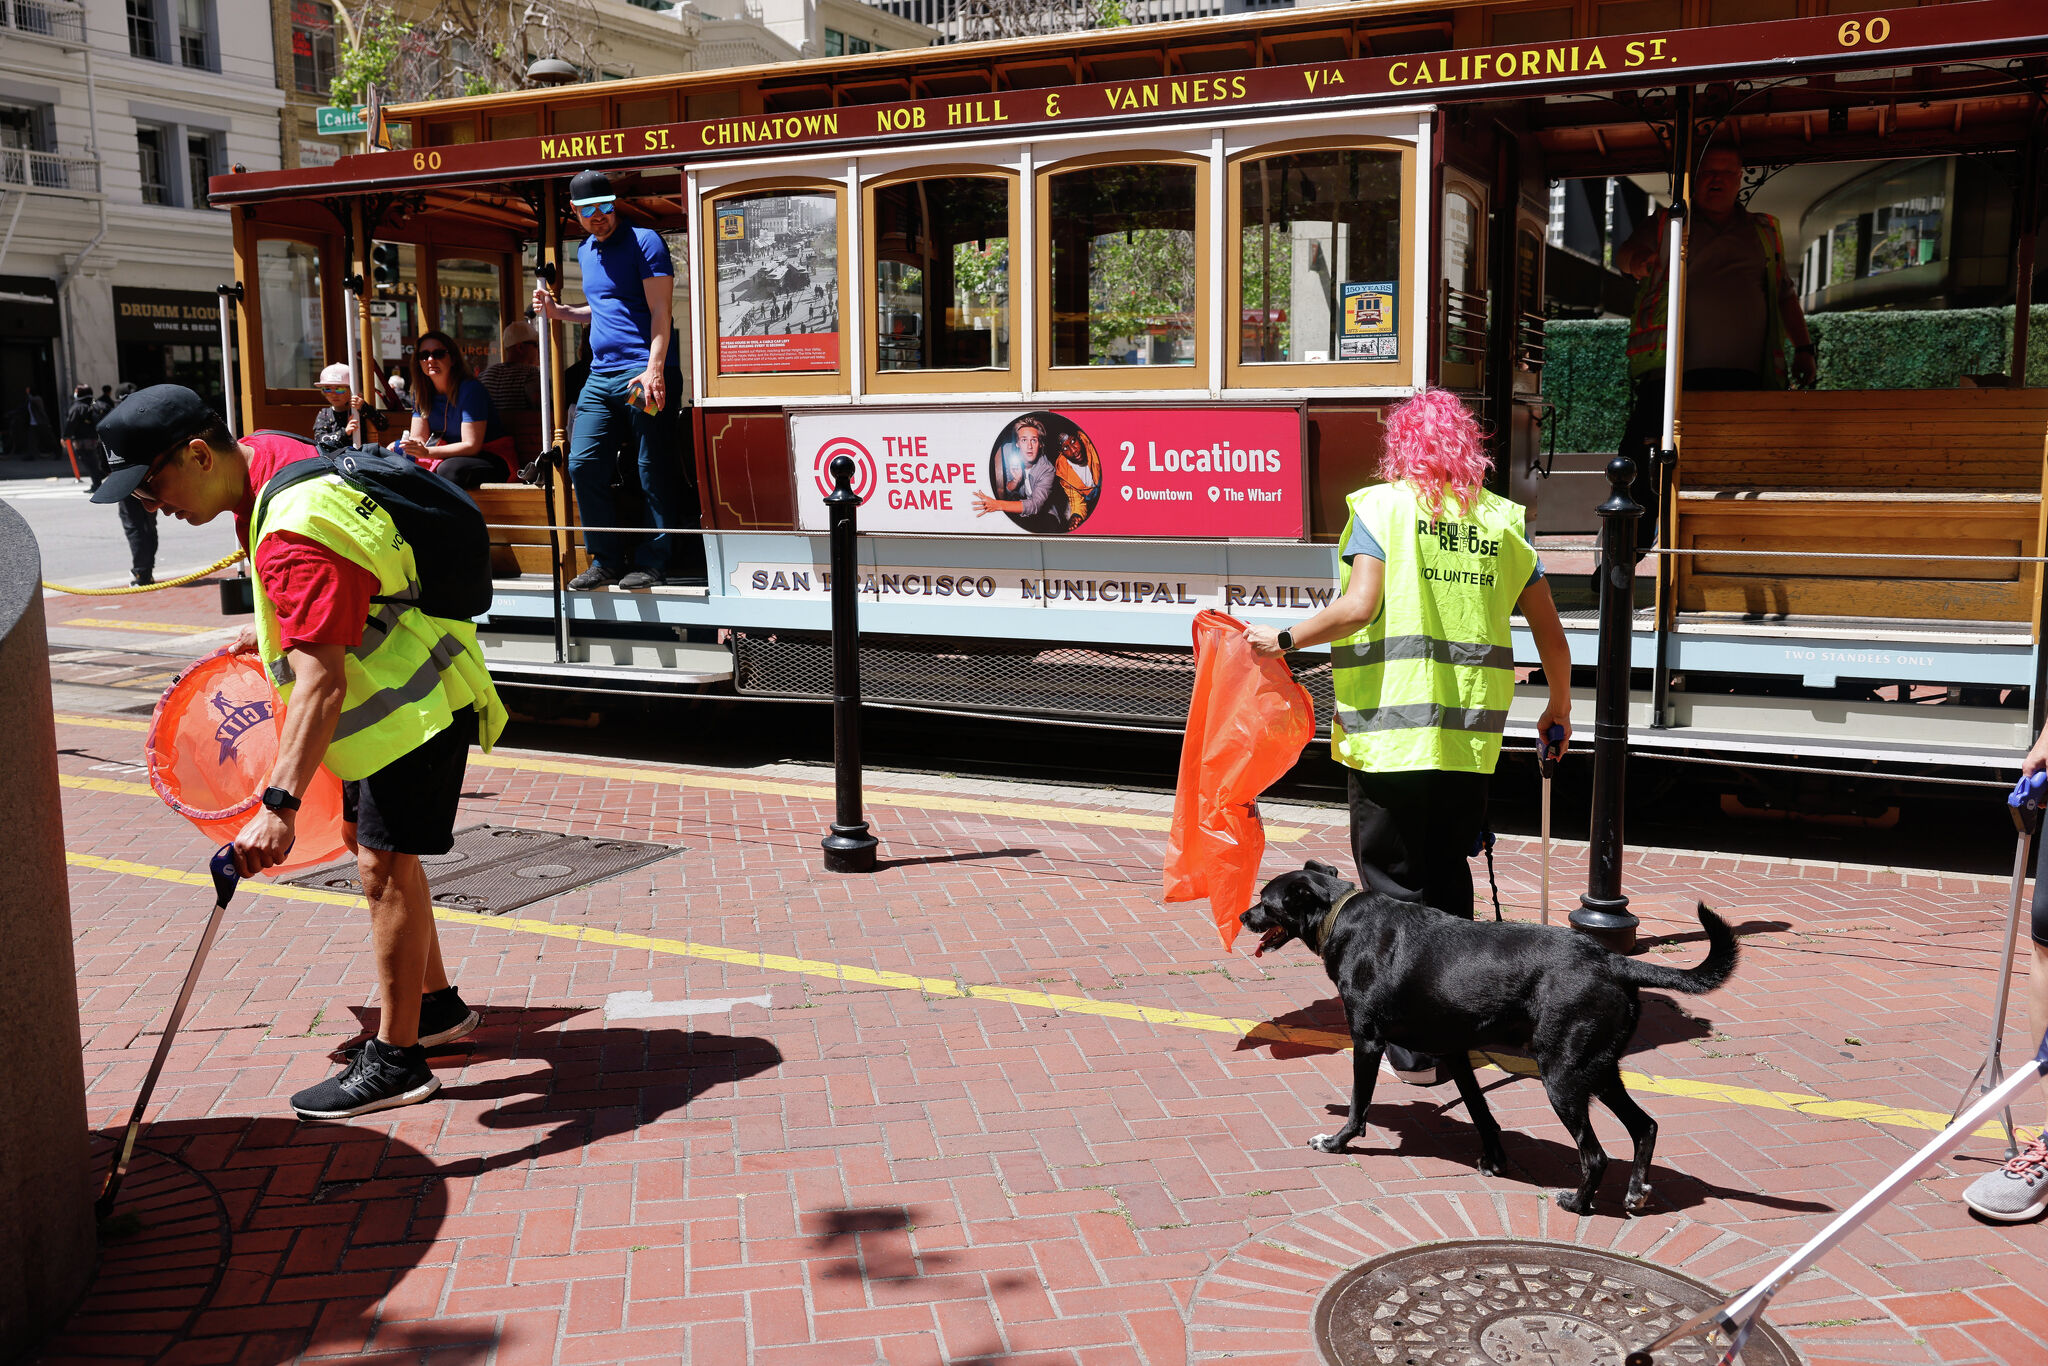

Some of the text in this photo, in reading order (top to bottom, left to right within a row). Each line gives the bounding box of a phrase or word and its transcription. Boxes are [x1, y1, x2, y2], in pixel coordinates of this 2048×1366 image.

[1837, 17, 1891, 47] 60
[541, 38, 1677, 159] MARKET ST. CHINATOWN NOB HILL & VAN NESS VIA CALIFORNIA ST.
[413, 151, 442, 171] 60
[1362, 284, 1392, 292] YEARS
[120, 303, 180, 318] DRUMM
[153, 322, 217, 332] WINE & BEER
[882, 436, 928, 457] THE
[1120, 441, 1281, 472] 2 Locations
[886, 463, 976, 484] ESCAPE
[888, 490, 953, 510] GAME
[1136, 487, 1193, 501] Downtown
[1223, 488, 1282, 502] The Wharf
[1418, 520, 1477, 540] REFUSE
[1440, 536, 1498, 556] REFUSE
[752, 569, 1341, 609] SAN FANCISCO MUNICIPAL RAILW
[1784, 650, 1935, 667] TWO STANDEES ONLY
